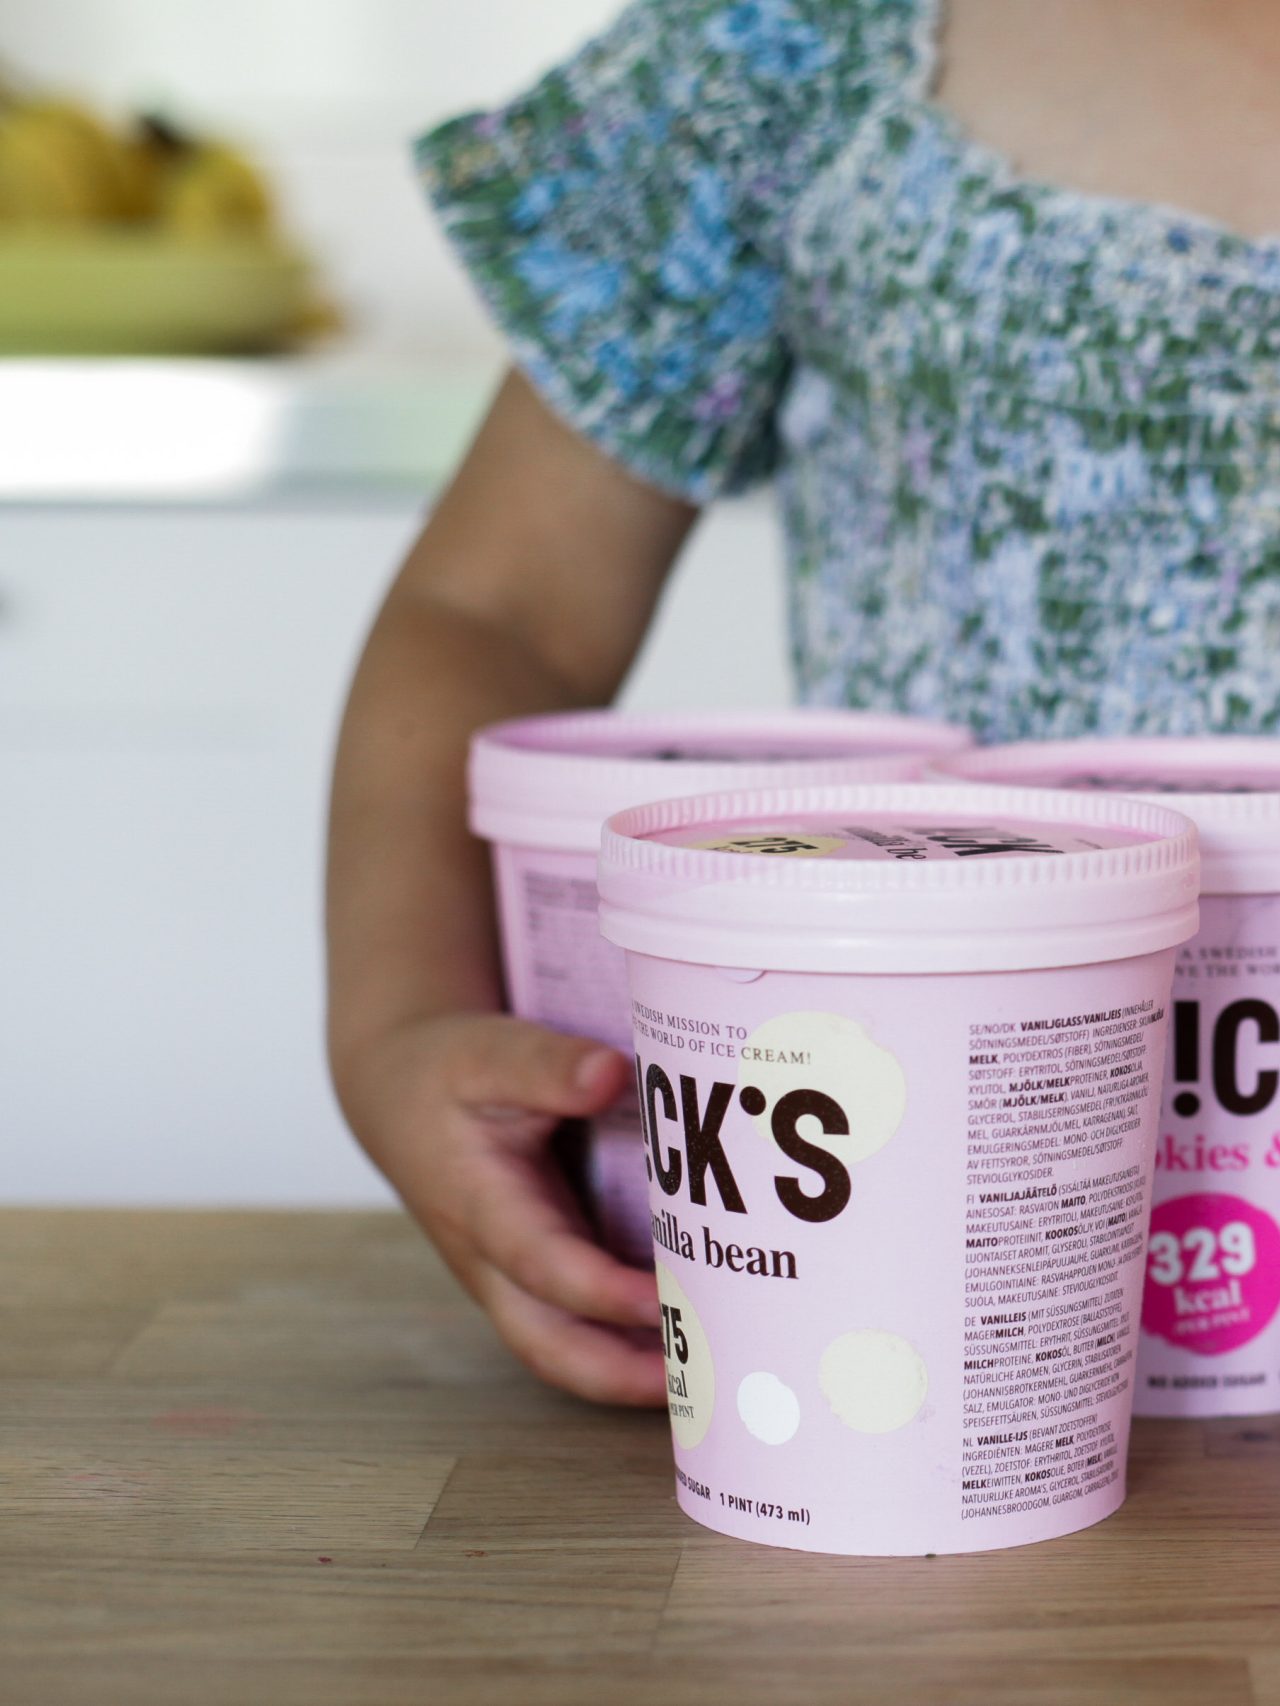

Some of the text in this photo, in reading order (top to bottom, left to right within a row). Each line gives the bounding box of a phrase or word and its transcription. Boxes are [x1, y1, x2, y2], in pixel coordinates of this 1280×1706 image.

[631, 998, 663, 1024] WEDISH
[667, 1015, 720, 1036] MISSION
[726, 1025, 748, 1040] TO
[969, 1023, 1016, 1035] SE/NO/DK
[1021, 1009, 1121, 1031] VANILJGLASS/VANILJEIS
[650, 1026, 685, 1049] WORLD
[688, 1038, 706, 1052] OF
[710, 1041, 736, 1058] ICE
[740, 1046, 812, 1065] CREAM!
[1003, 1047, 1062, 1063] POLYDEXTROS
[968, 1098, 996, 1111] SMÖR
[1018, 1102, 1102, 1121] STABILISERINGSMEDEL
[1091, 1130, 1105, 1140] OCH
[967, 1159, 979, 1169] AV
[967, 1195, 974, 1204] FI
[979, 1186, 1057, 1203] VANILJAJÄÄTELÖ
[1095, 1220, 1105, 1230] VOI
[650, 1208, 799, 1280] anilla bean
[966, 1250, 1016, 1263] LUONTAISET
[1149, 1222, 1257, 1285] 329
[1173, 1278, 1242, 1315] kcal
[965, 1316, 976, 1327] DE
[981, 1312, 1027, 1325] VANILLEIS
[1028, 1307, 1044, 1322] (MIT
[661, 1303, 689, 1364] 75
[1028, 1316, 1079, 1335] POLYDEXTROSE
[1073, 1342, 1094, 1354] BUTTER
[964, 1371, 1014, 1385] NATÜRLICHE
[1064, 1388, 1077, 1399] UND
[963, 1438, 973, 1447] NL
[977, 1431, 1028, 1446] VANILLE-IJS
[1025, 1440, 1054, 1454] MAGERE
[1067, 1460, 1084, 1473] BOTER
[687, 1476, 811, 1525] SUGAR 1 PINT (473 ml)
[962, 1490, 1014, 1505] NATUURLIJKE
